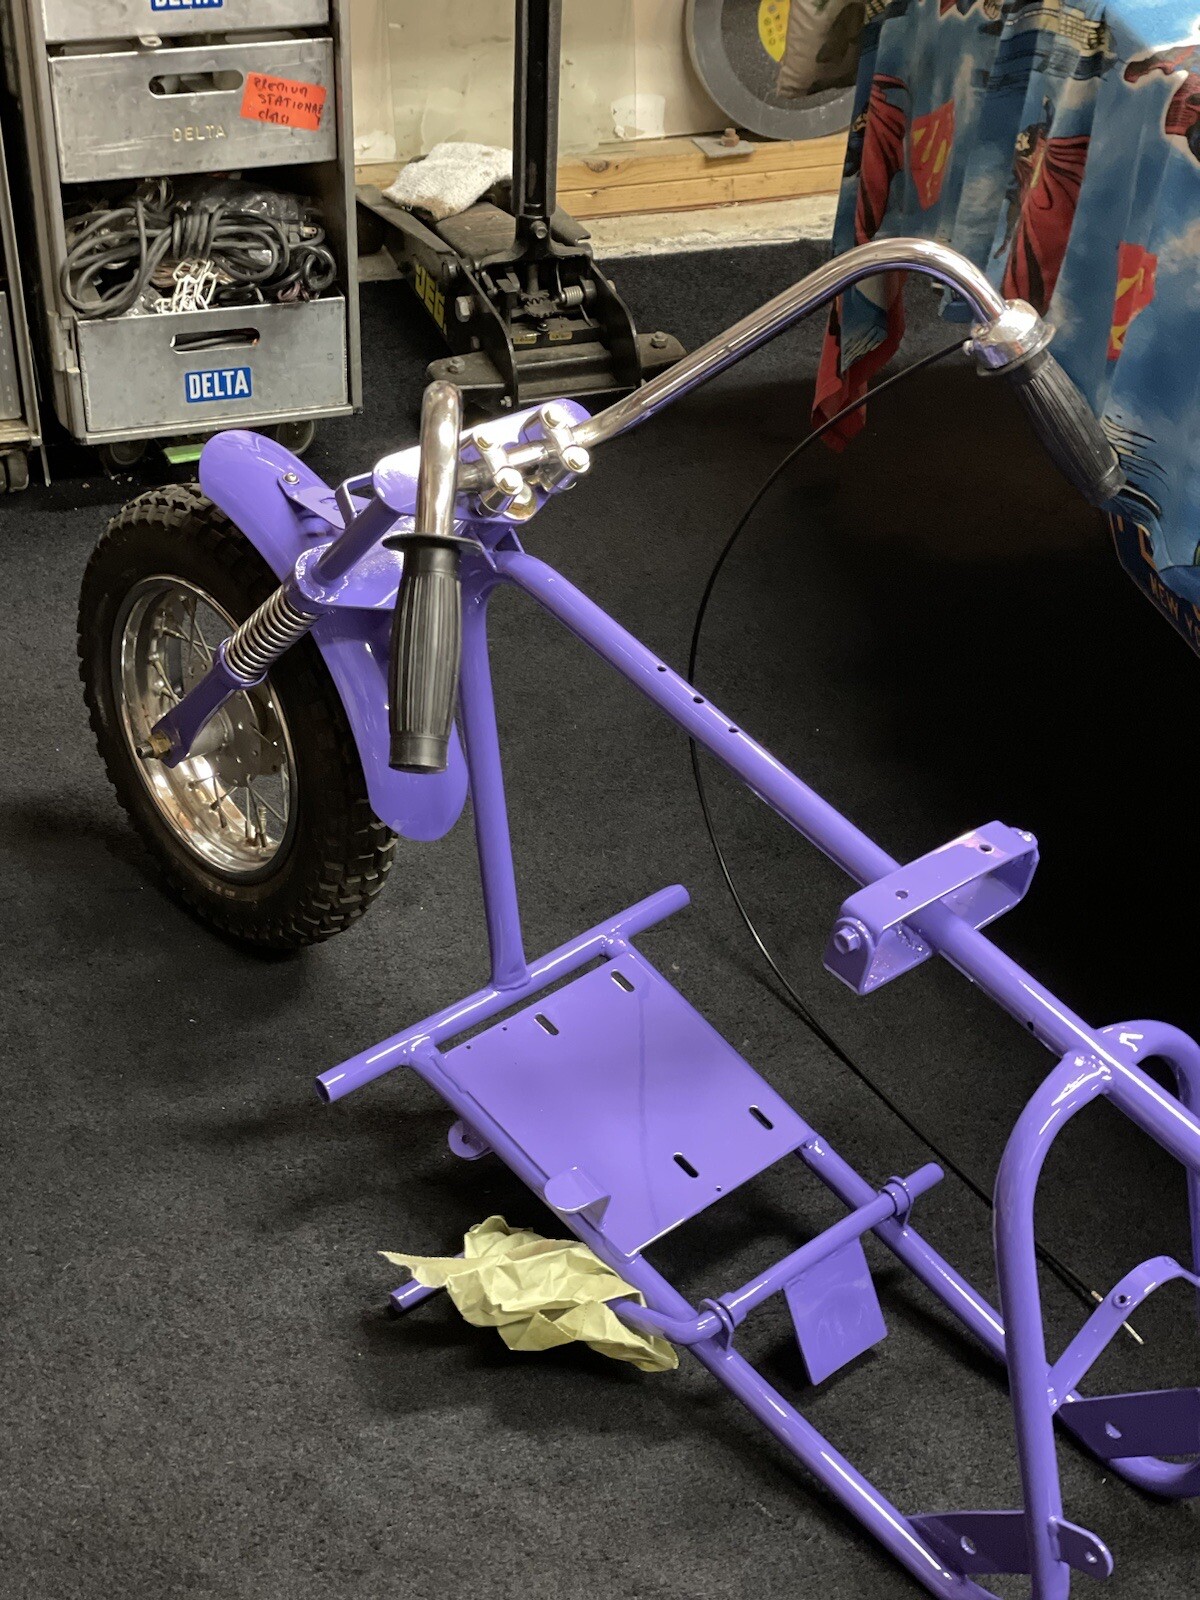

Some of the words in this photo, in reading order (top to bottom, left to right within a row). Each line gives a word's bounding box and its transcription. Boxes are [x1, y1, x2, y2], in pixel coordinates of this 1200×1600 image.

[172, 125, 227, 143] DELTA
[415, 262, 447, 336] JEG
[188, 369, 250, 400] DELTA
